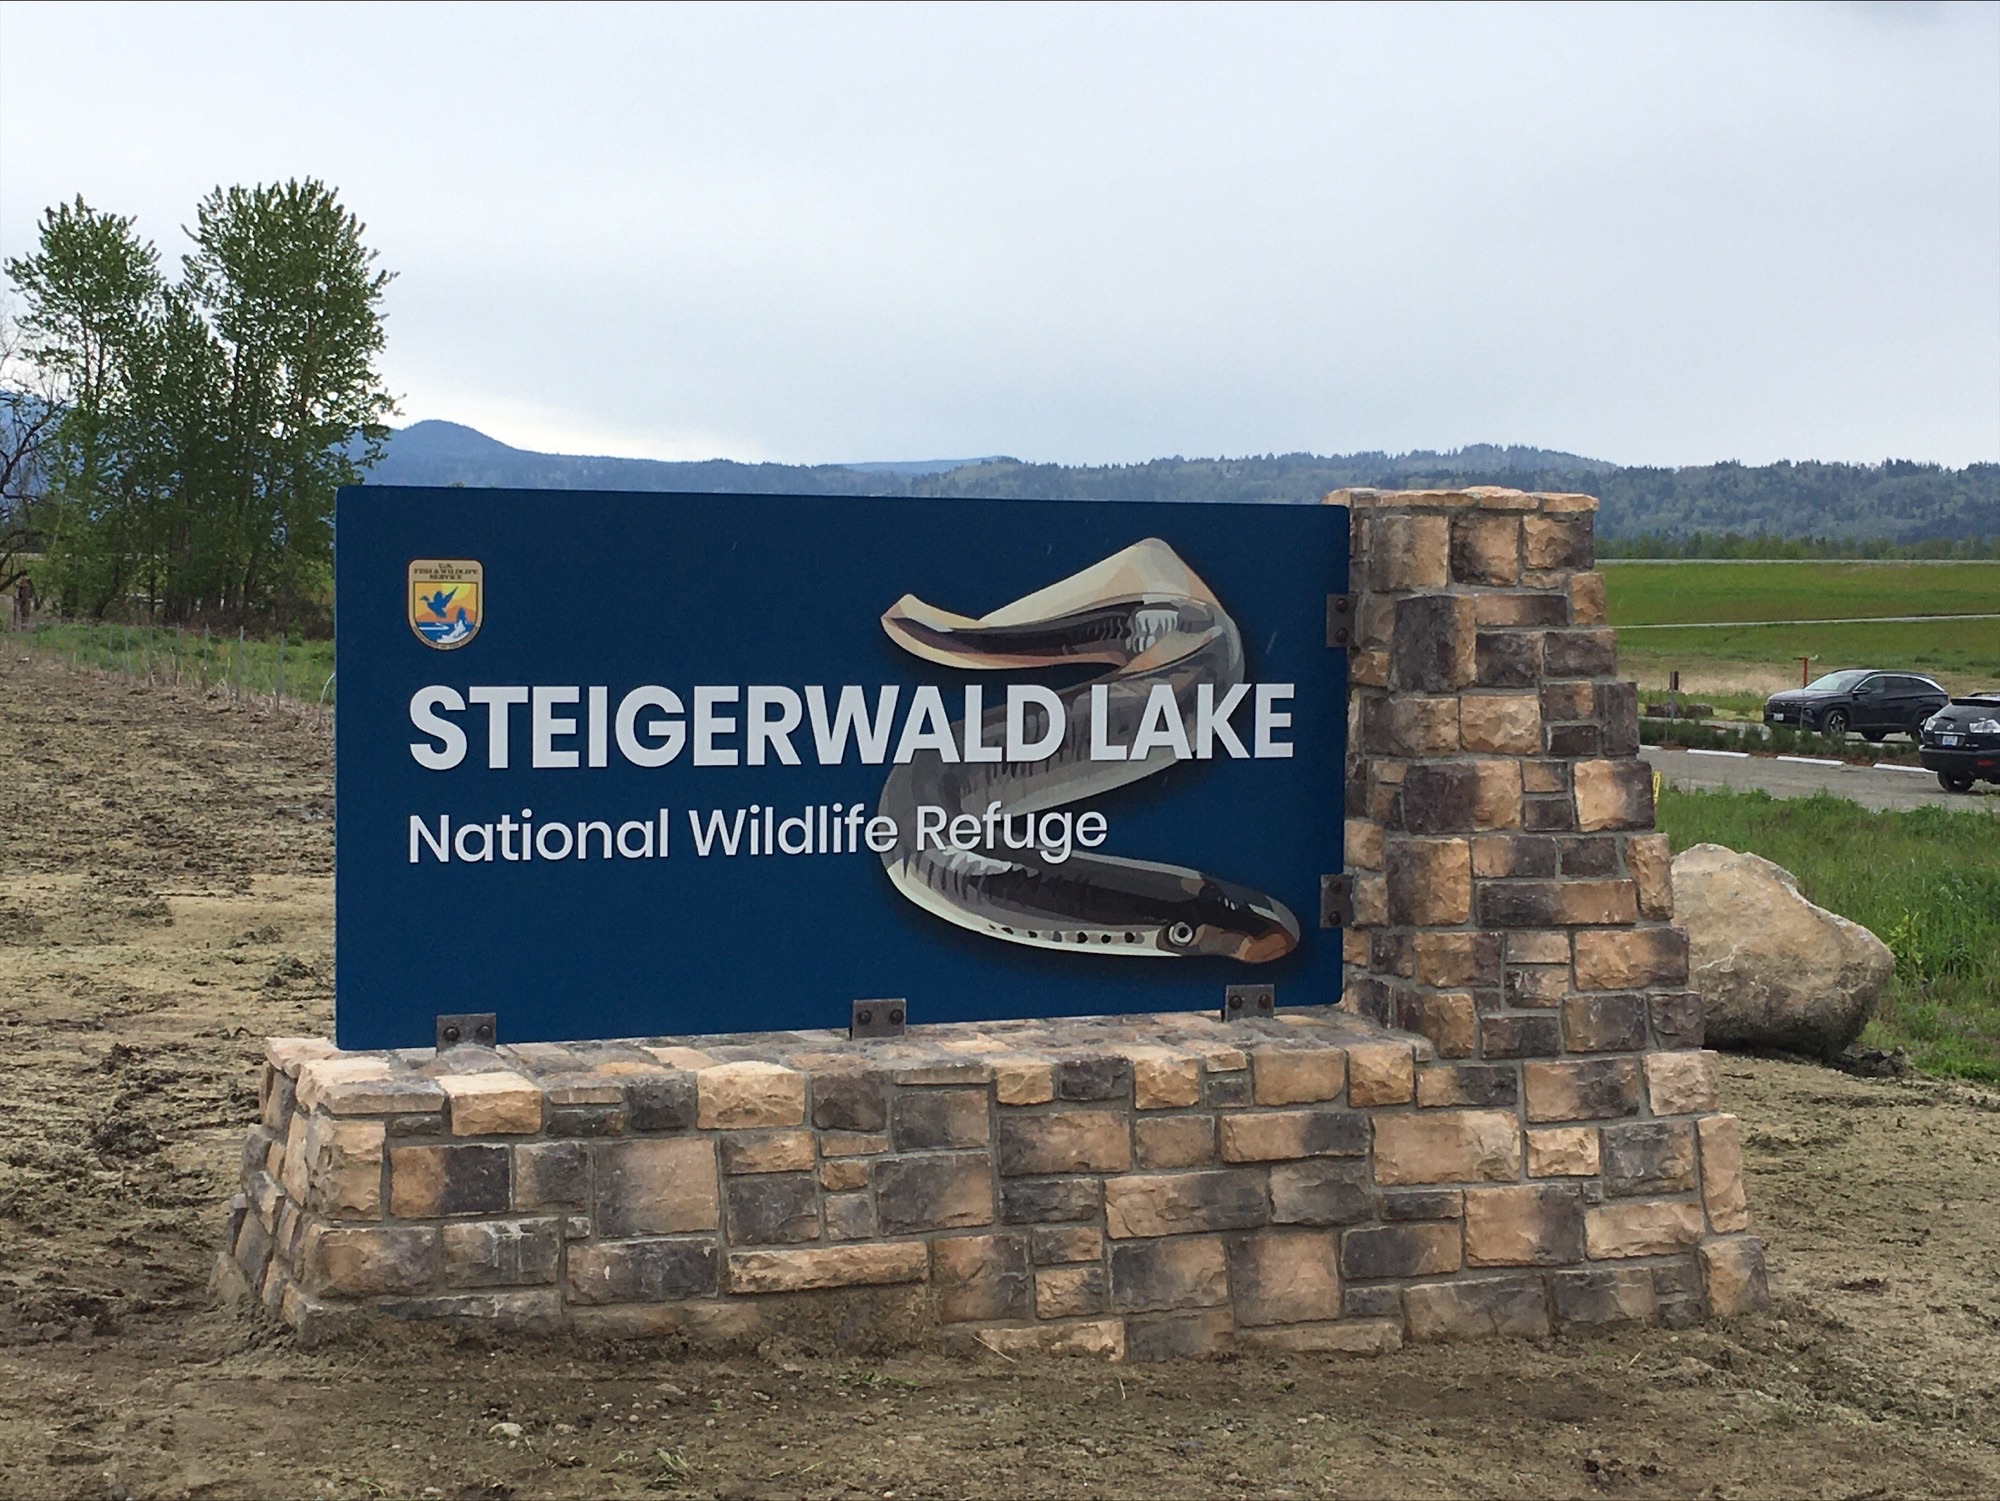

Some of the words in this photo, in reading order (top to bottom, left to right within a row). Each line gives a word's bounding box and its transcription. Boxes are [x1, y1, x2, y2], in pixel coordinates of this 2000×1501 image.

[409, 684, 1067, 771] STEIGERWALD
[1090, 683, 1296, 761] LAKE
[409, 808, 669, 864] National
[688, 802, 899, 857] Wildlife
[916, 800, 1109, 865] Refuge
